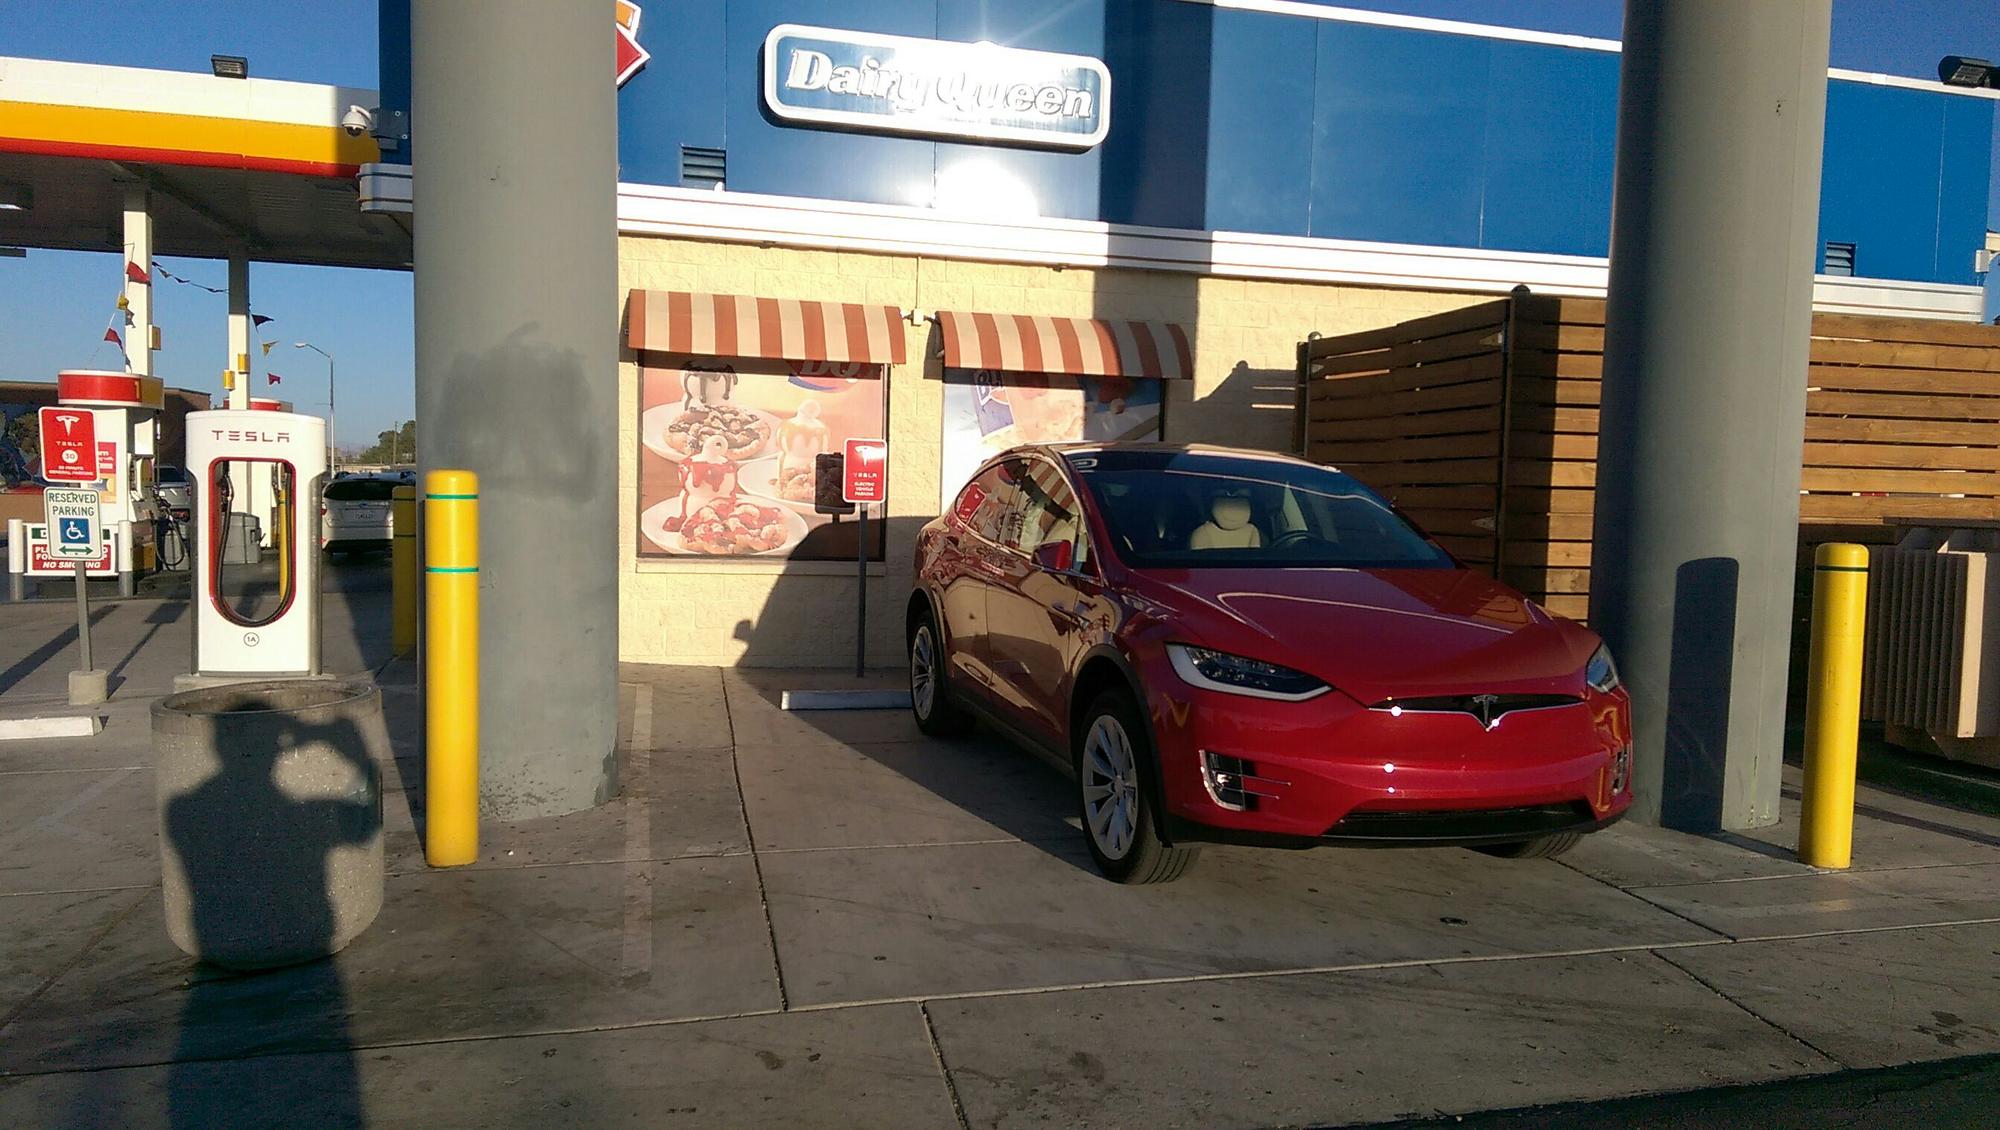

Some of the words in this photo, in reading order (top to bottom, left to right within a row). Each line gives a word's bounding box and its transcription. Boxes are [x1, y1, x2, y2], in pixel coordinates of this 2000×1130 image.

[787, 48, 929, 113] Dairy
[936, 70, 1094, 119] Queen
[211, 430, 290, 443] TESLA
[48, 492, 97, 504] RESERVED
[52, 505, 95, 516] PARKING
[42, 561, 57, 569] NO
